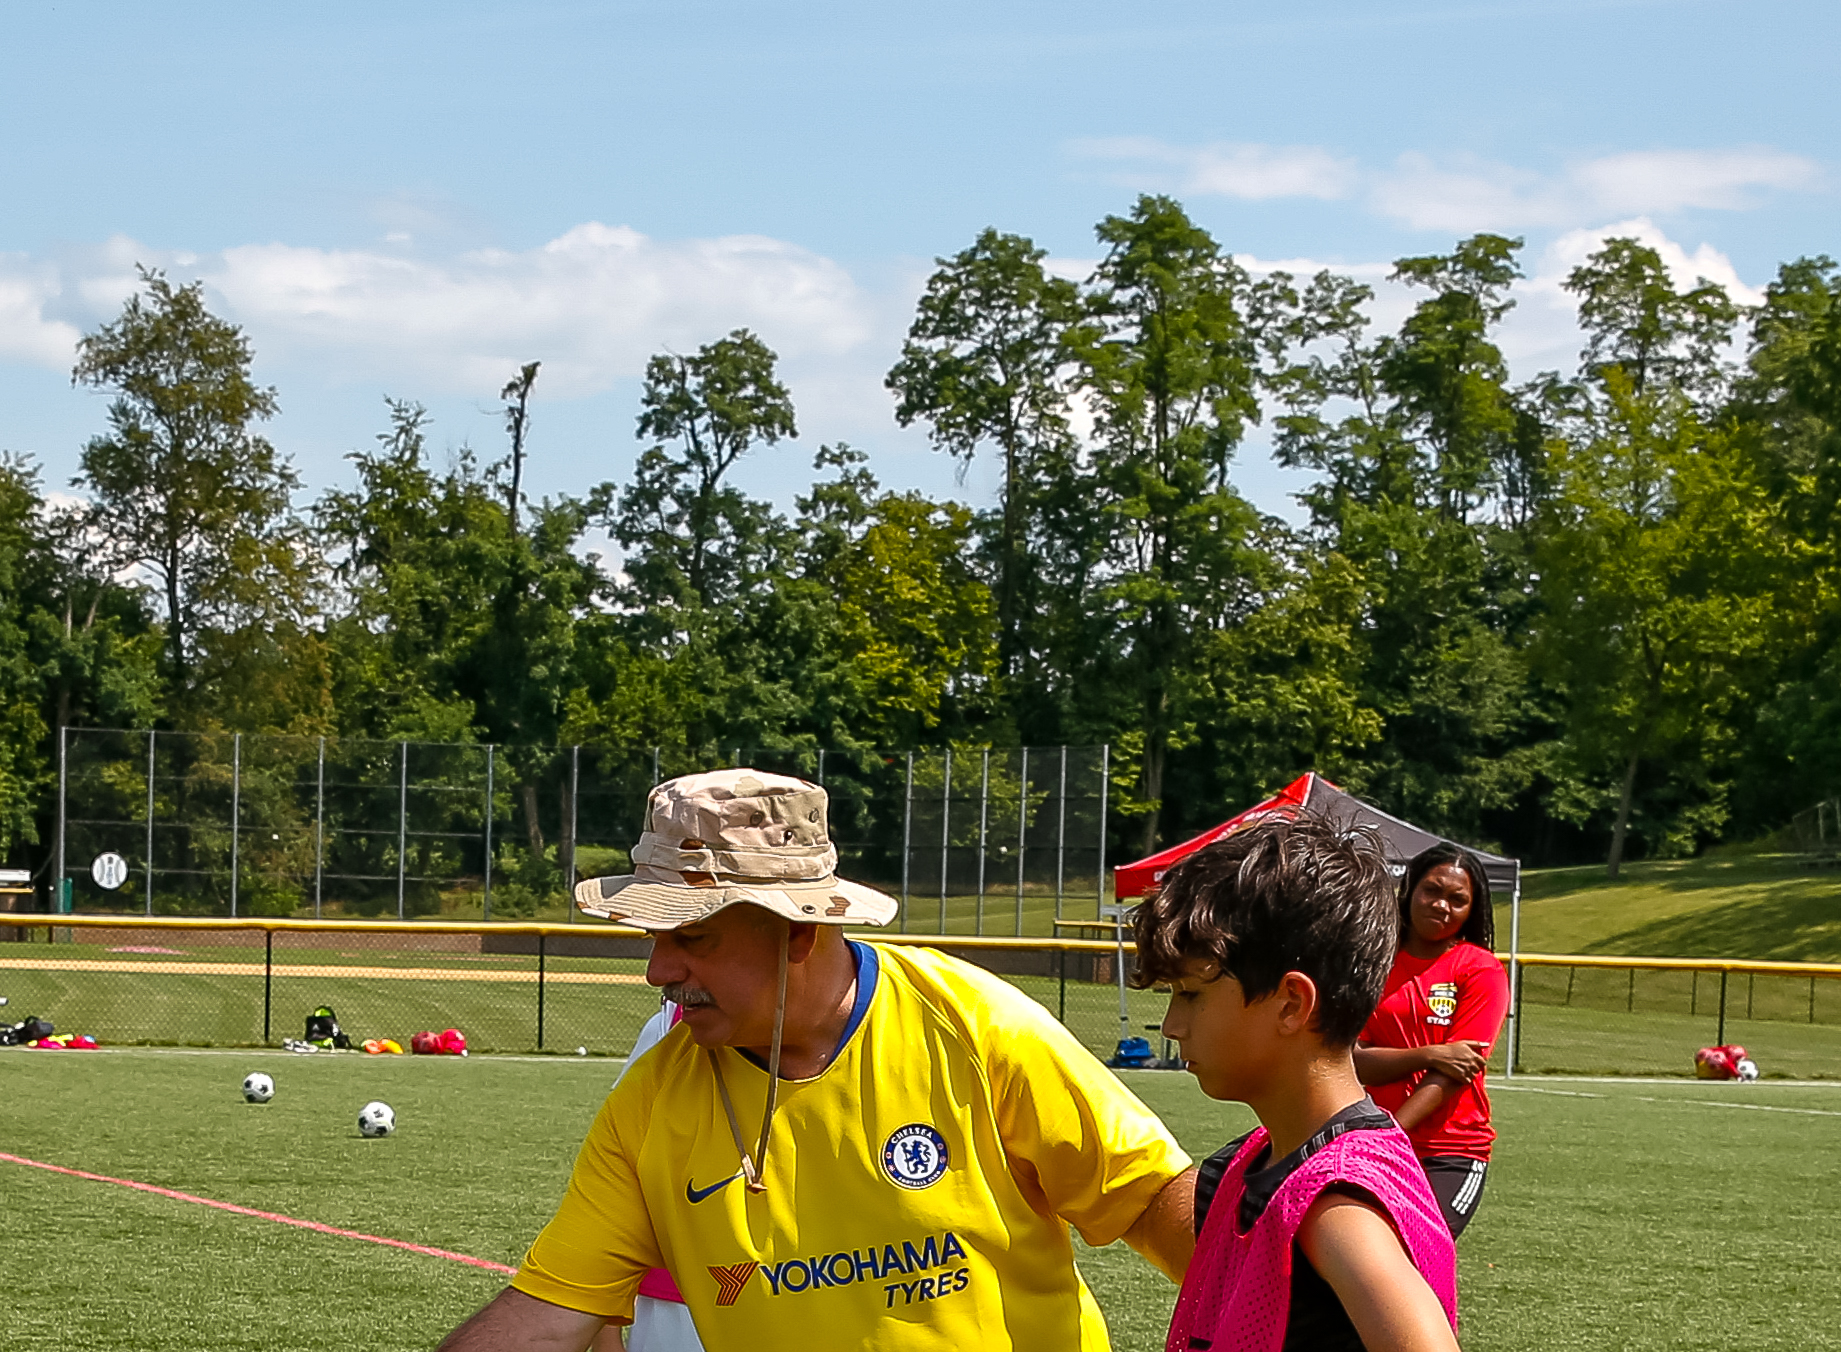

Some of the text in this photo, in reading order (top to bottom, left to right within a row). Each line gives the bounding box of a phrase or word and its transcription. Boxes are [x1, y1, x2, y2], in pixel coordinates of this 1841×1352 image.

[891, 1127, 932, 1144] CHELSEA
[761, 1231, 968, 1296] YOKOHAMA
[884, 1267, 970, 1308] TYRES
